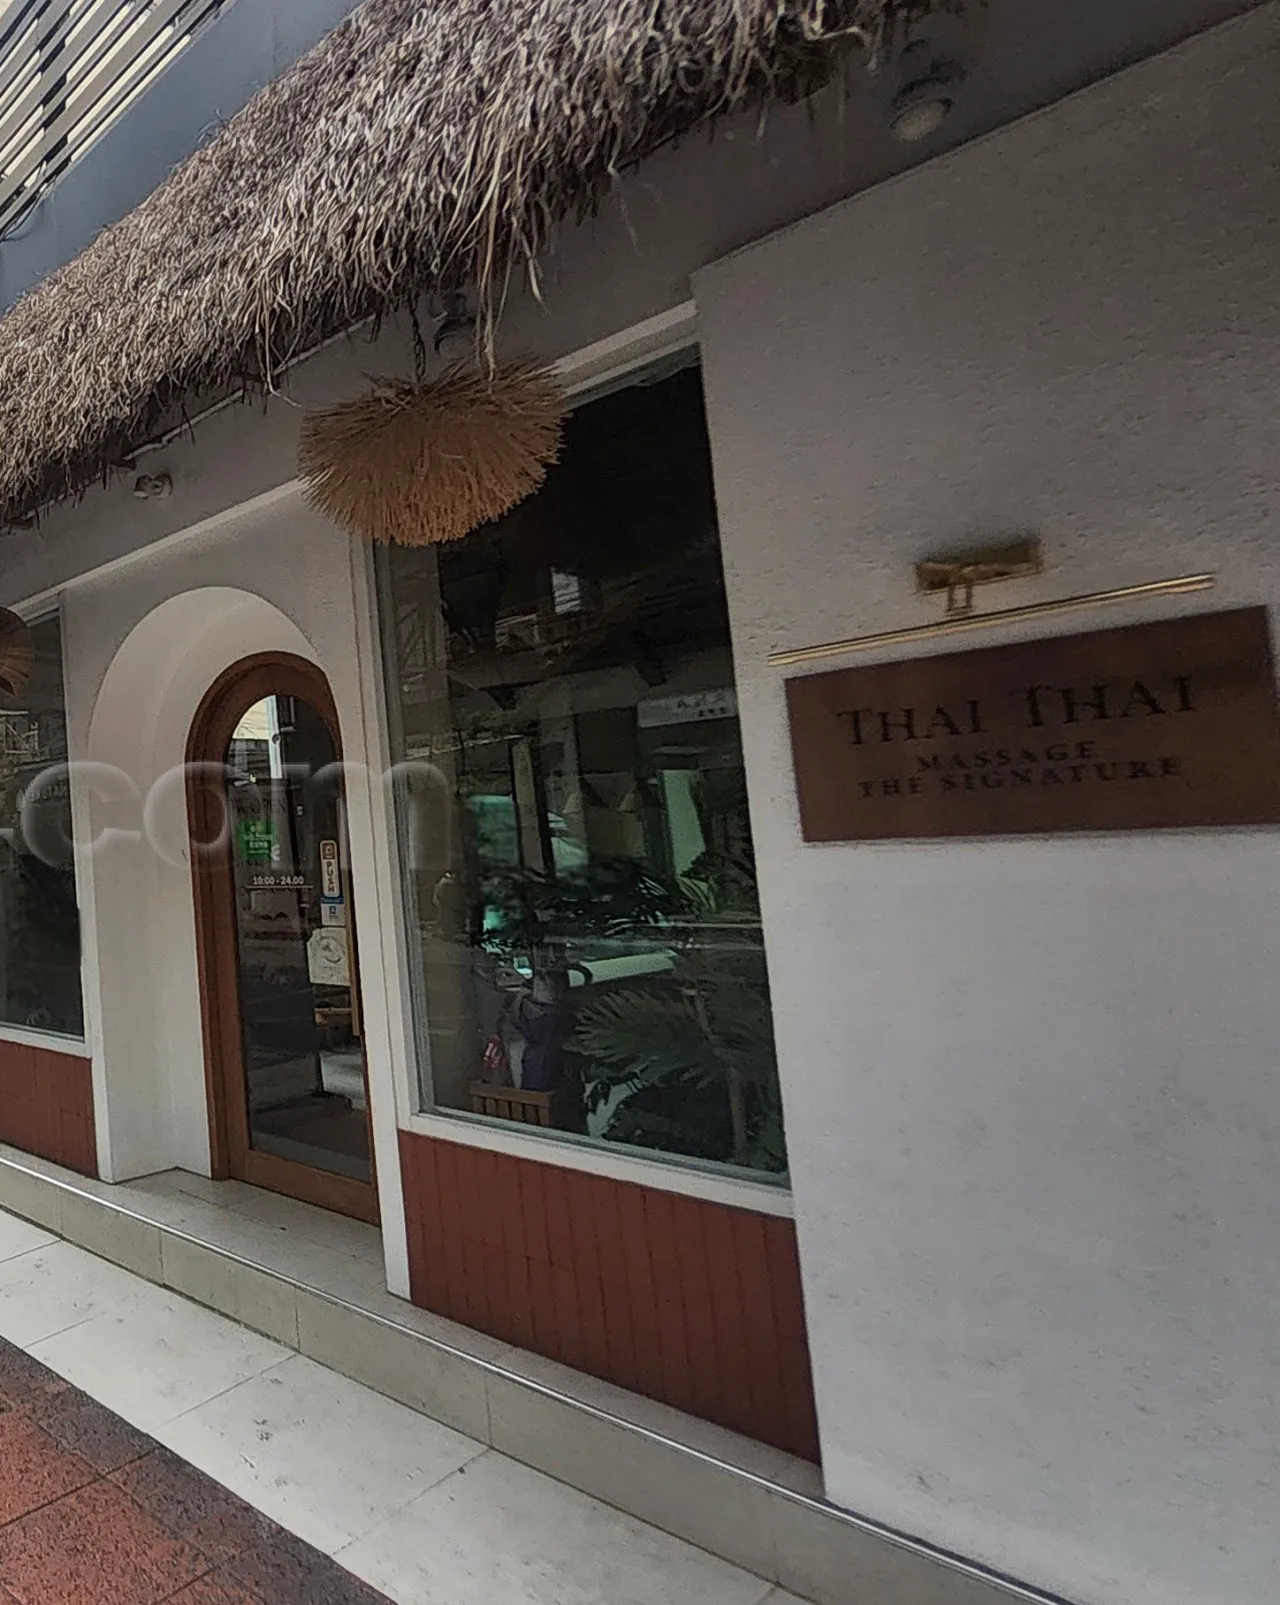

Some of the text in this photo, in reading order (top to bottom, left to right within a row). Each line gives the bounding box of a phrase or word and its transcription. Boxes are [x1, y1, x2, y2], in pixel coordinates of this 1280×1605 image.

[834, 670, 1197, 746] THAI THAI
[916, 740, 1103, 773] MASSAGE
[855, 756, 1184, 801] THE SIGNATURE
[326, 861, 335, 893] PUSH
